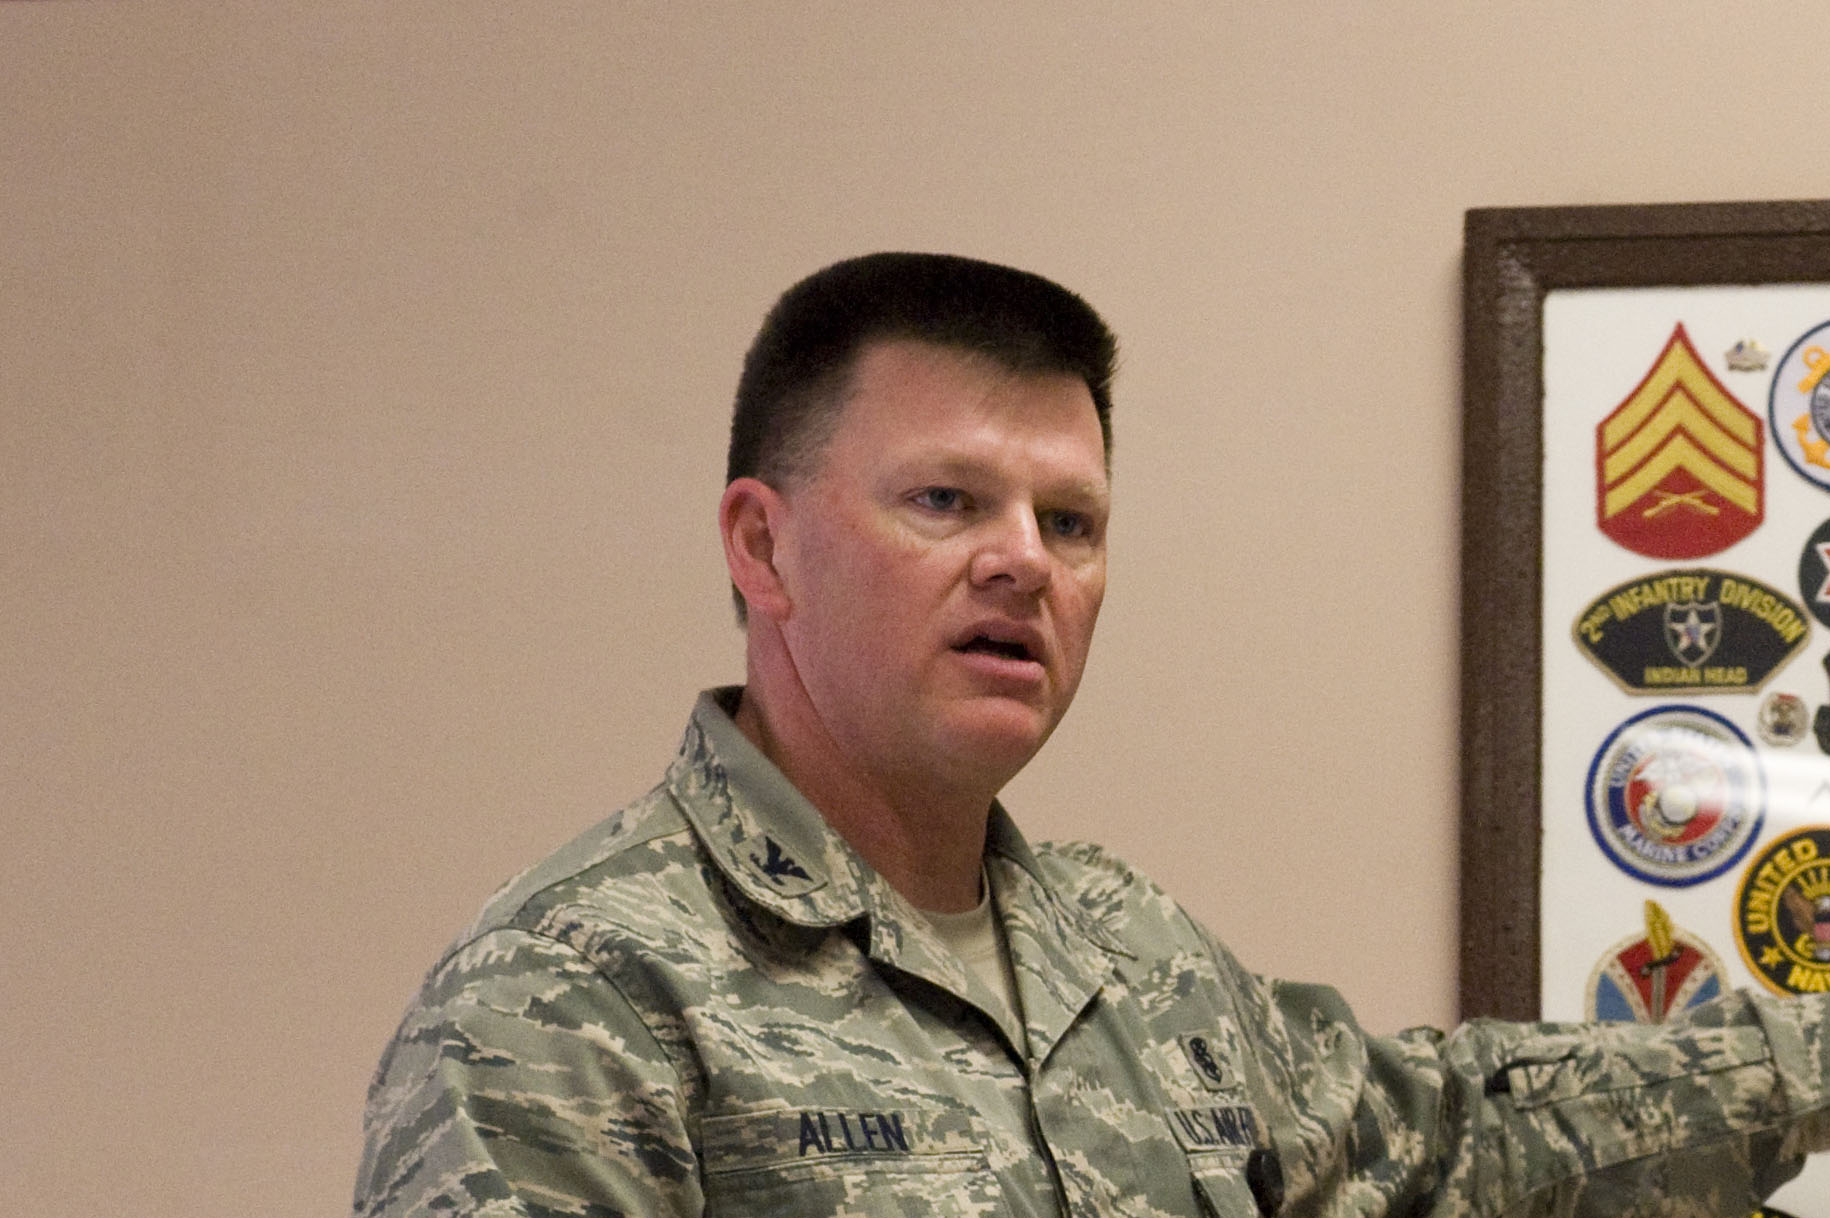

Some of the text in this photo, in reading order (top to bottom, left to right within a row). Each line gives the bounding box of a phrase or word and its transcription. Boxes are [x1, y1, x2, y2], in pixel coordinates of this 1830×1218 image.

[1609, 577, 1710, 622] INFANTRY
[1720, 579, 1806, 643] DIVISION
[1703, 666, 1748, 683] HEAD
[1617, 824, 1689, 862] MARINE
[1747, 838, 1818, 934] UNITED
[800, 1110, 909, 1157] ALLEN
